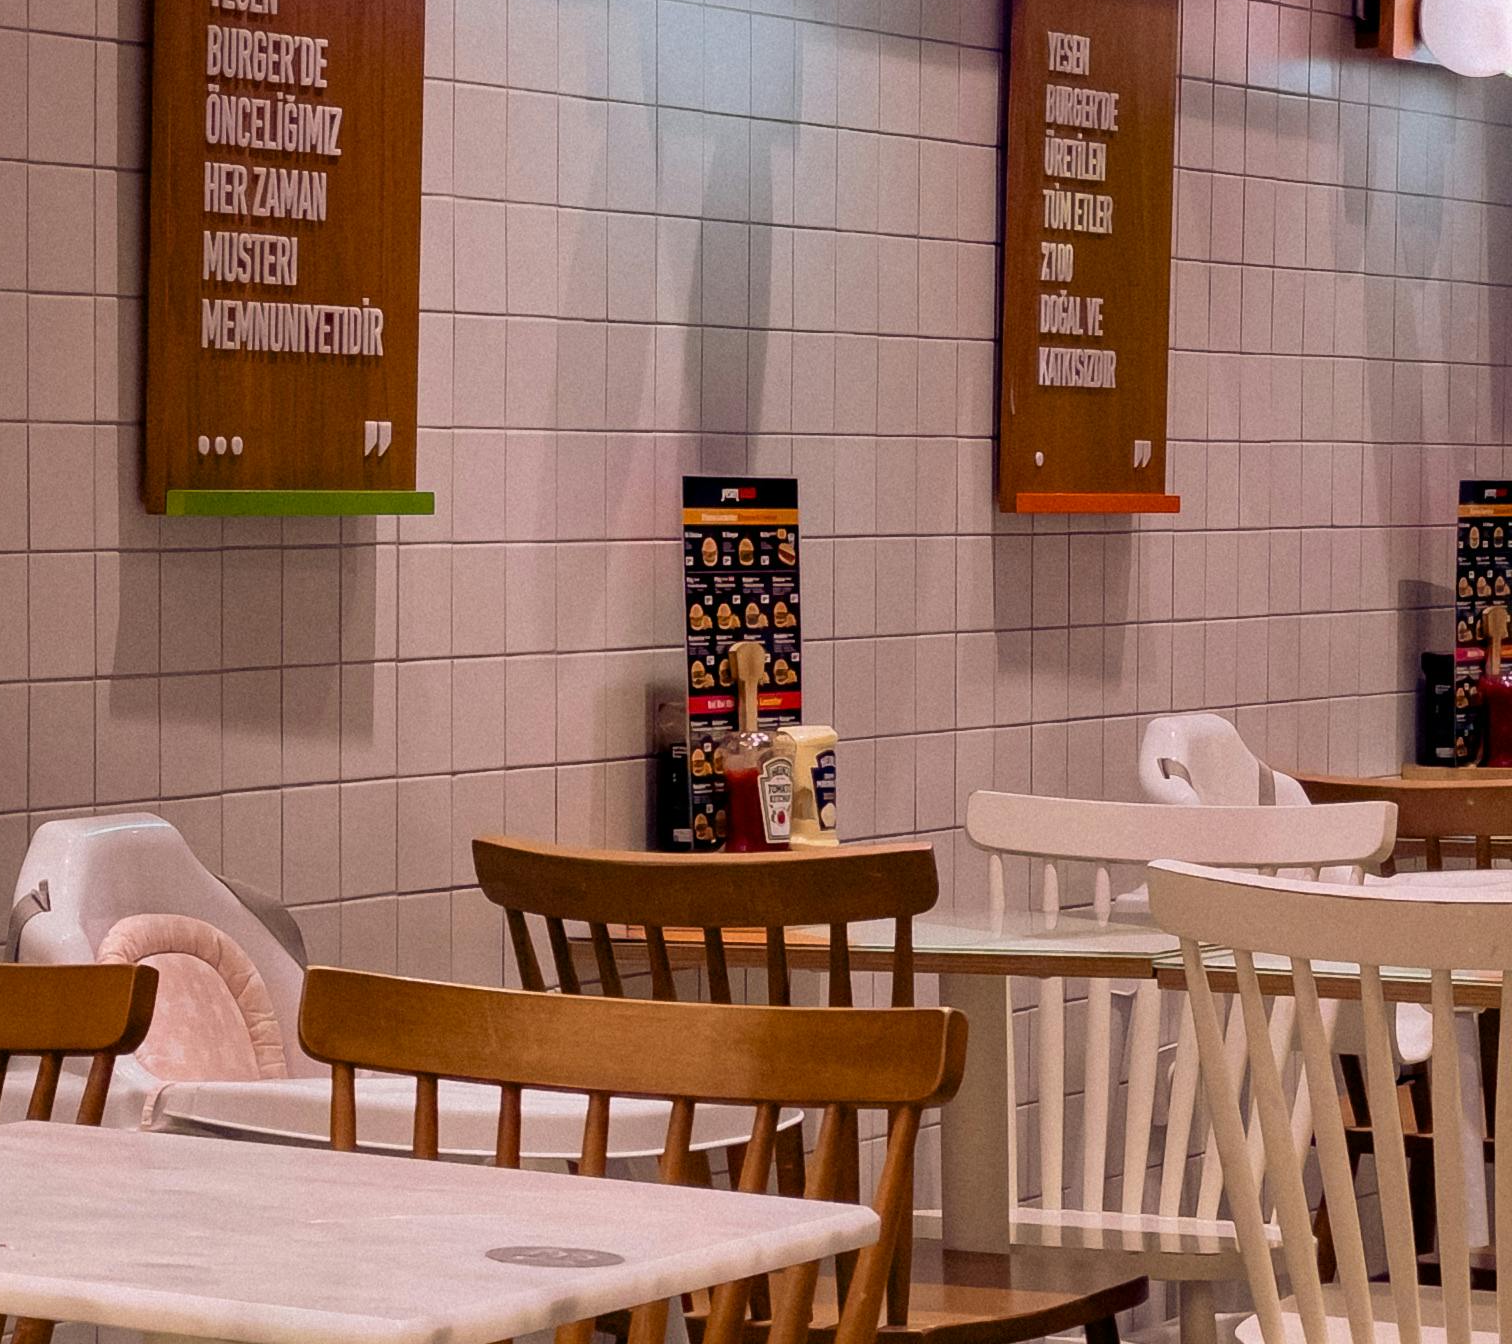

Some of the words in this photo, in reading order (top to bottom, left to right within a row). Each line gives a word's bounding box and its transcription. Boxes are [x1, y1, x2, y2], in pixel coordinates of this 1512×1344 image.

[206, 24, 329, 88] BURGER'DE
[1047, 31, 1090, 76] YESEN
[204, 161, 248, 215] HER
[252, 166, 327, 222] ZAMAN
[1074, 192, 1114, 235] ETLER
[1086, 297, 1104, 337] VE
